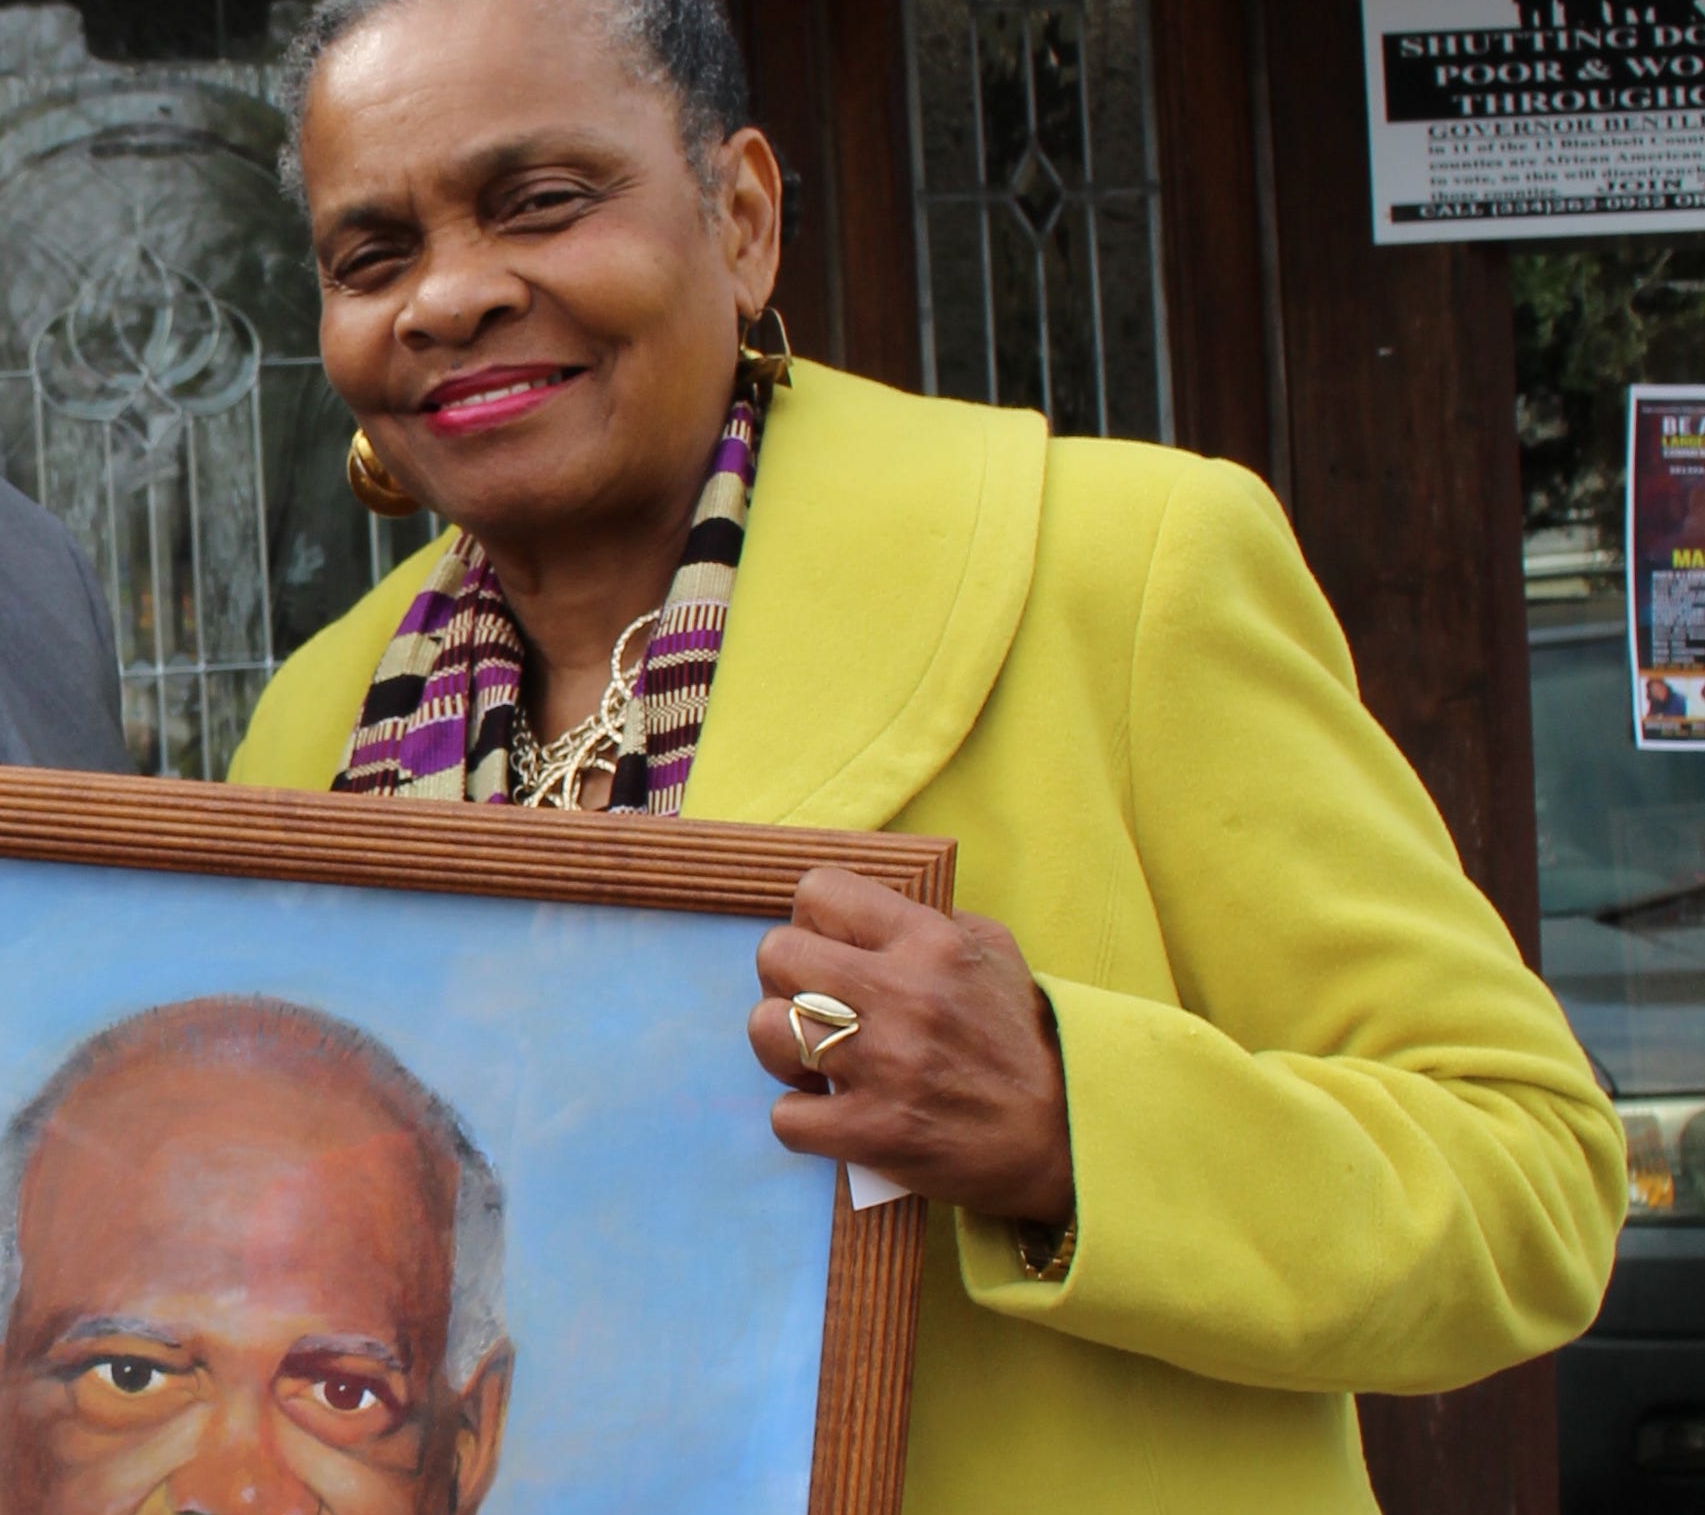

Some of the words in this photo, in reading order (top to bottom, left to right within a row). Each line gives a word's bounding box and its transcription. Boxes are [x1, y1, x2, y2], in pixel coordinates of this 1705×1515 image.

[1399, 25, 1638, 59] SHUTTING
[1434, 59, 1565, 88] POOR
[1576, 56, 1613, 82] &
[1428, 116, 1593, 140] GOVERNOR
[1418, 201, 1484, 219] CALL
